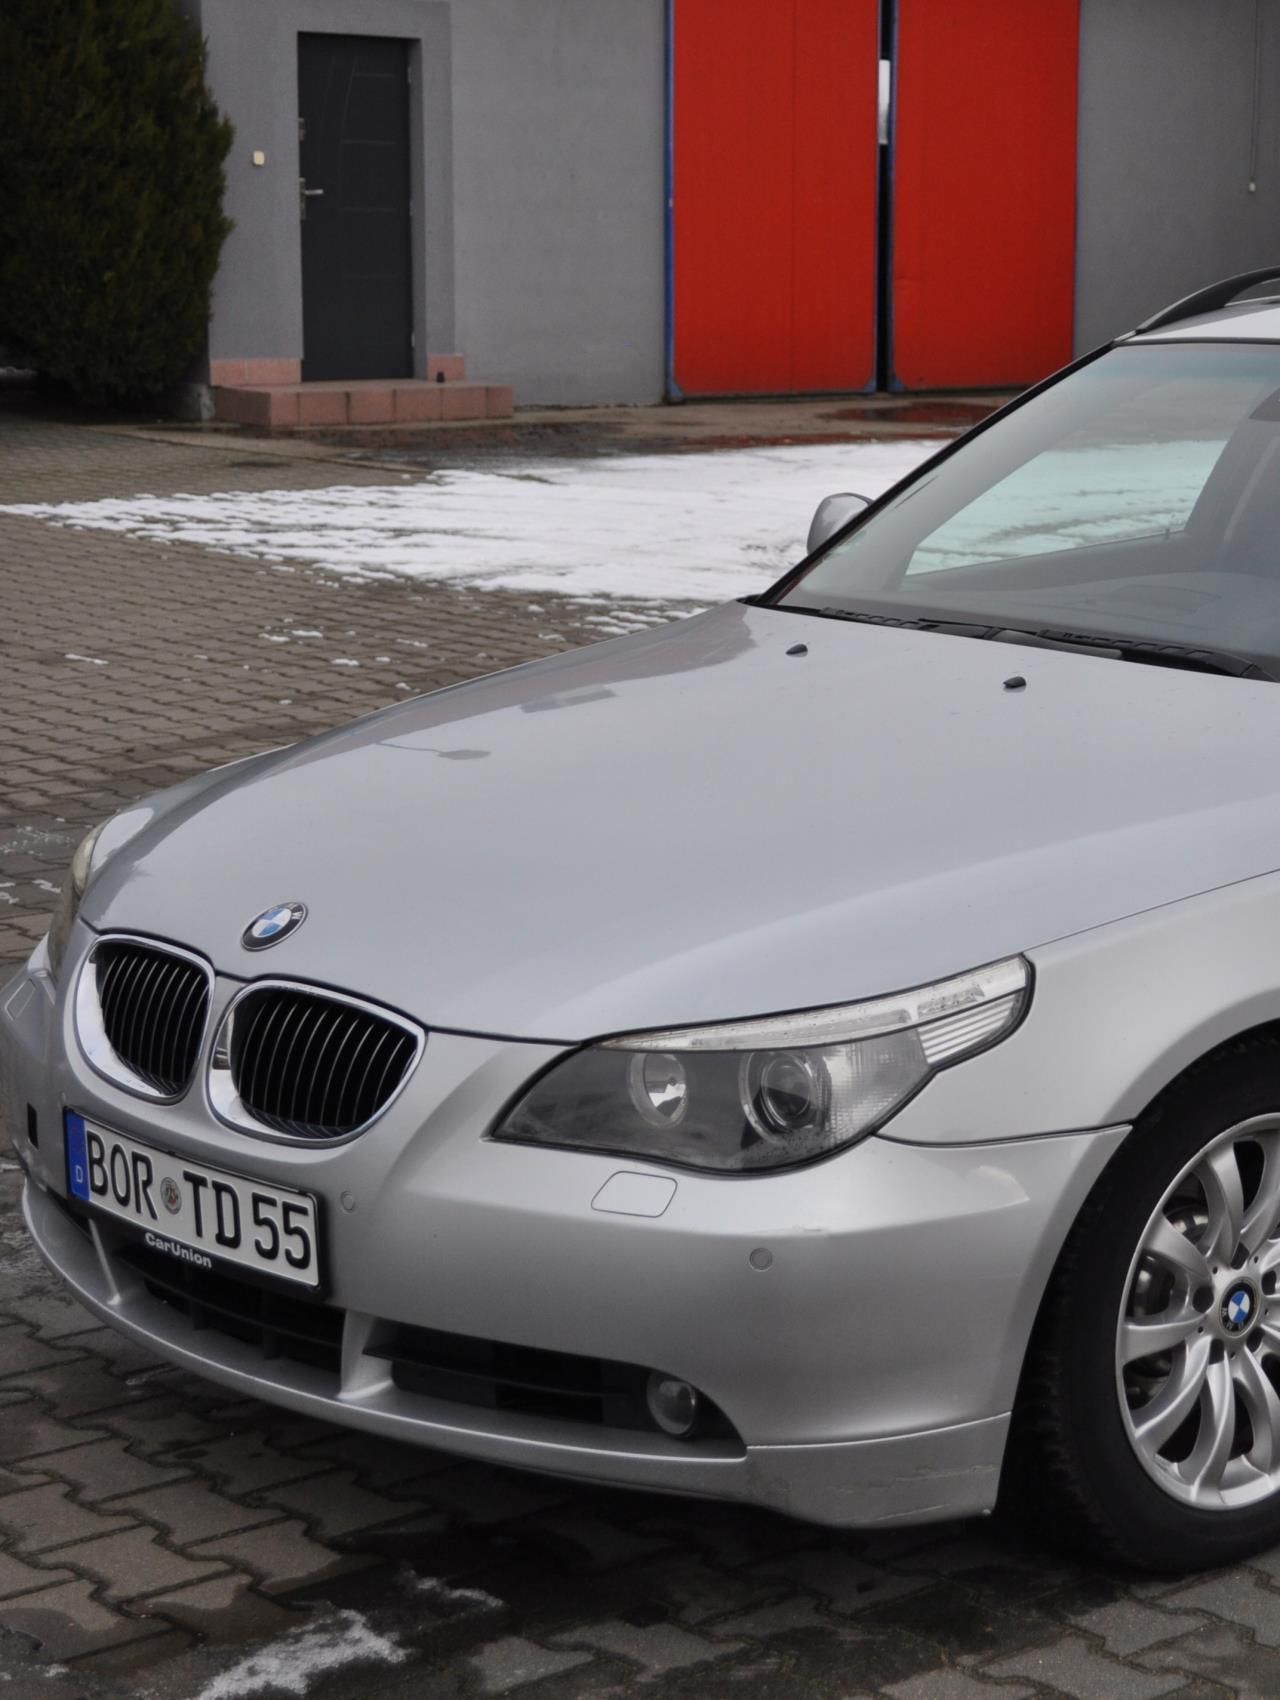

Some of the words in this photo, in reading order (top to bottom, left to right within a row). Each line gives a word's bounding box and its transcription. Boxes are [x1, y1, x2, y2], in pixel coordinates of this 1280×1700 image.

[75, 1164, 84, 1184] D
[86, 1130, 158, 1221] BOR
[183, 1169, 242, 1250] TD
[251, 1191, 312, 1270] 55
[144, 1232, 213, 1269] CarUnion
